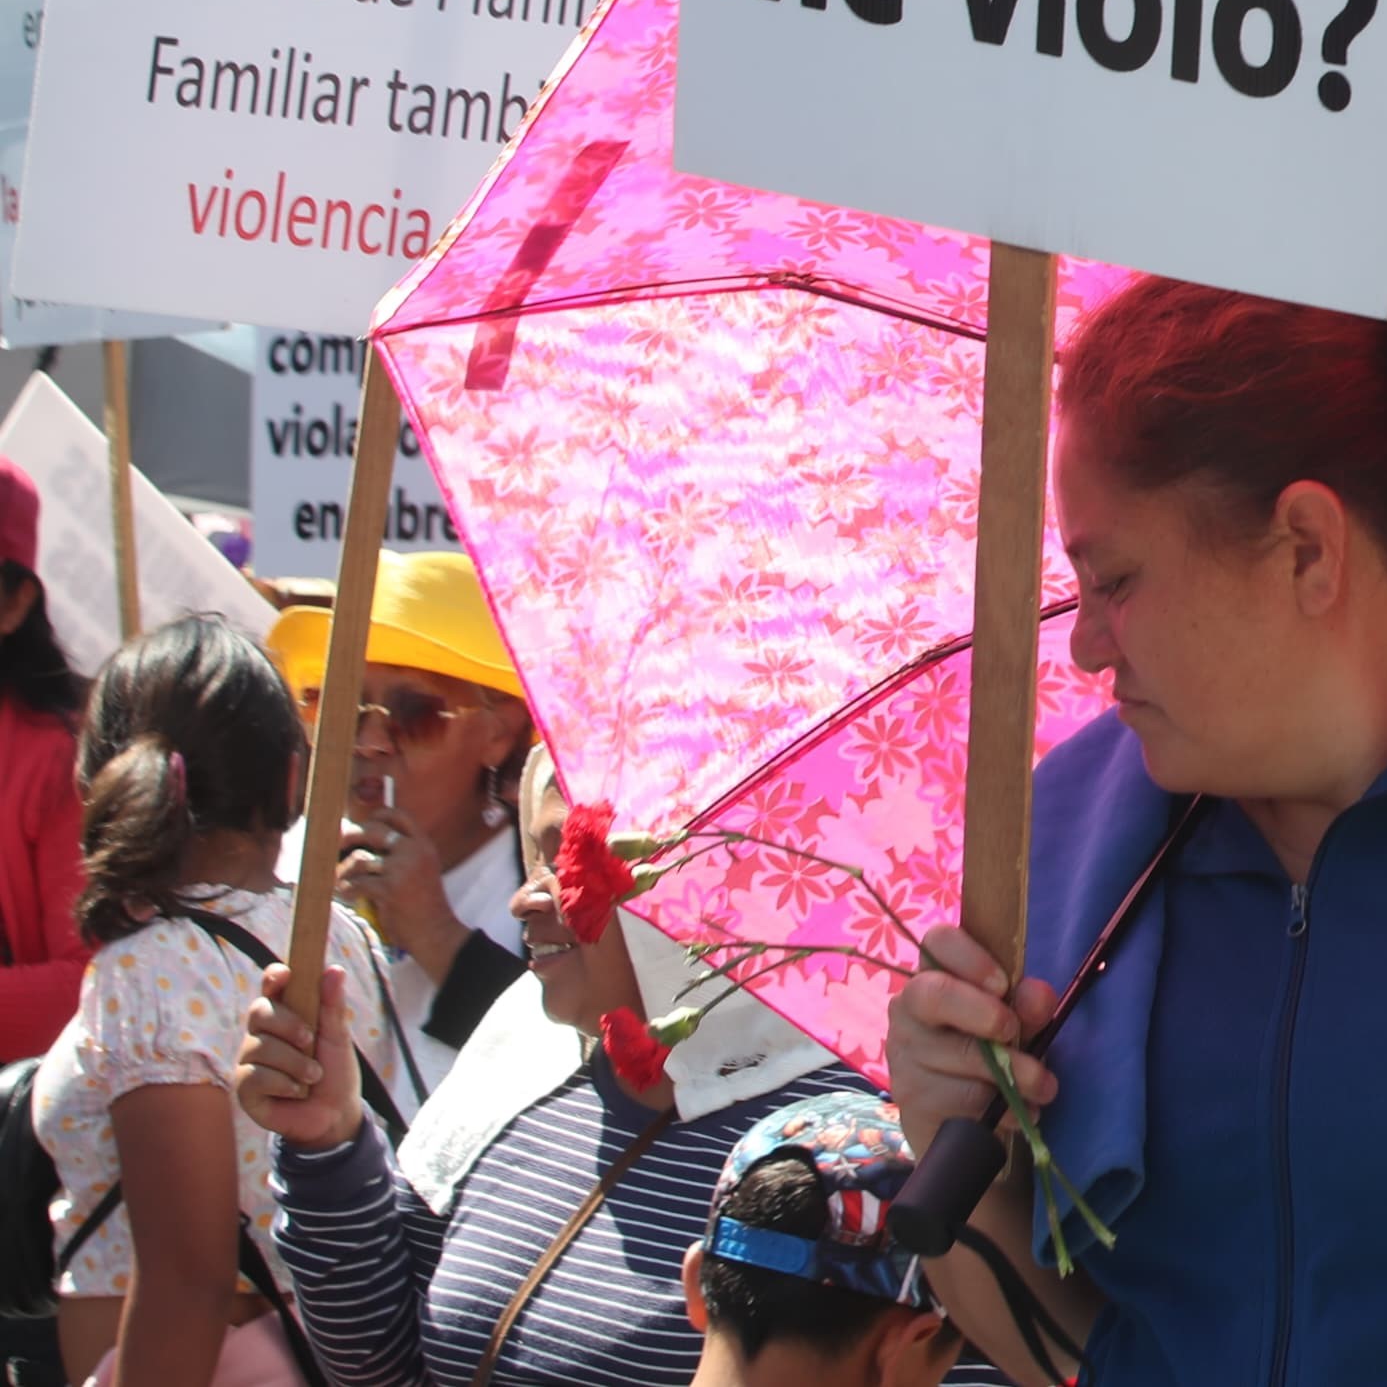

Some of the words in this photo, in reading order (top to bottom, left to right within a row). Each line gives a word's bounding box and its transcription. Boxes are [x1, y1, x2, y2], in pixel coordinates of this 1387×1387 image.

[147, 35, 369, 127] Familiar
[387, 68, 546, 143] tamb
[187, 168, 432, 260] violencia
